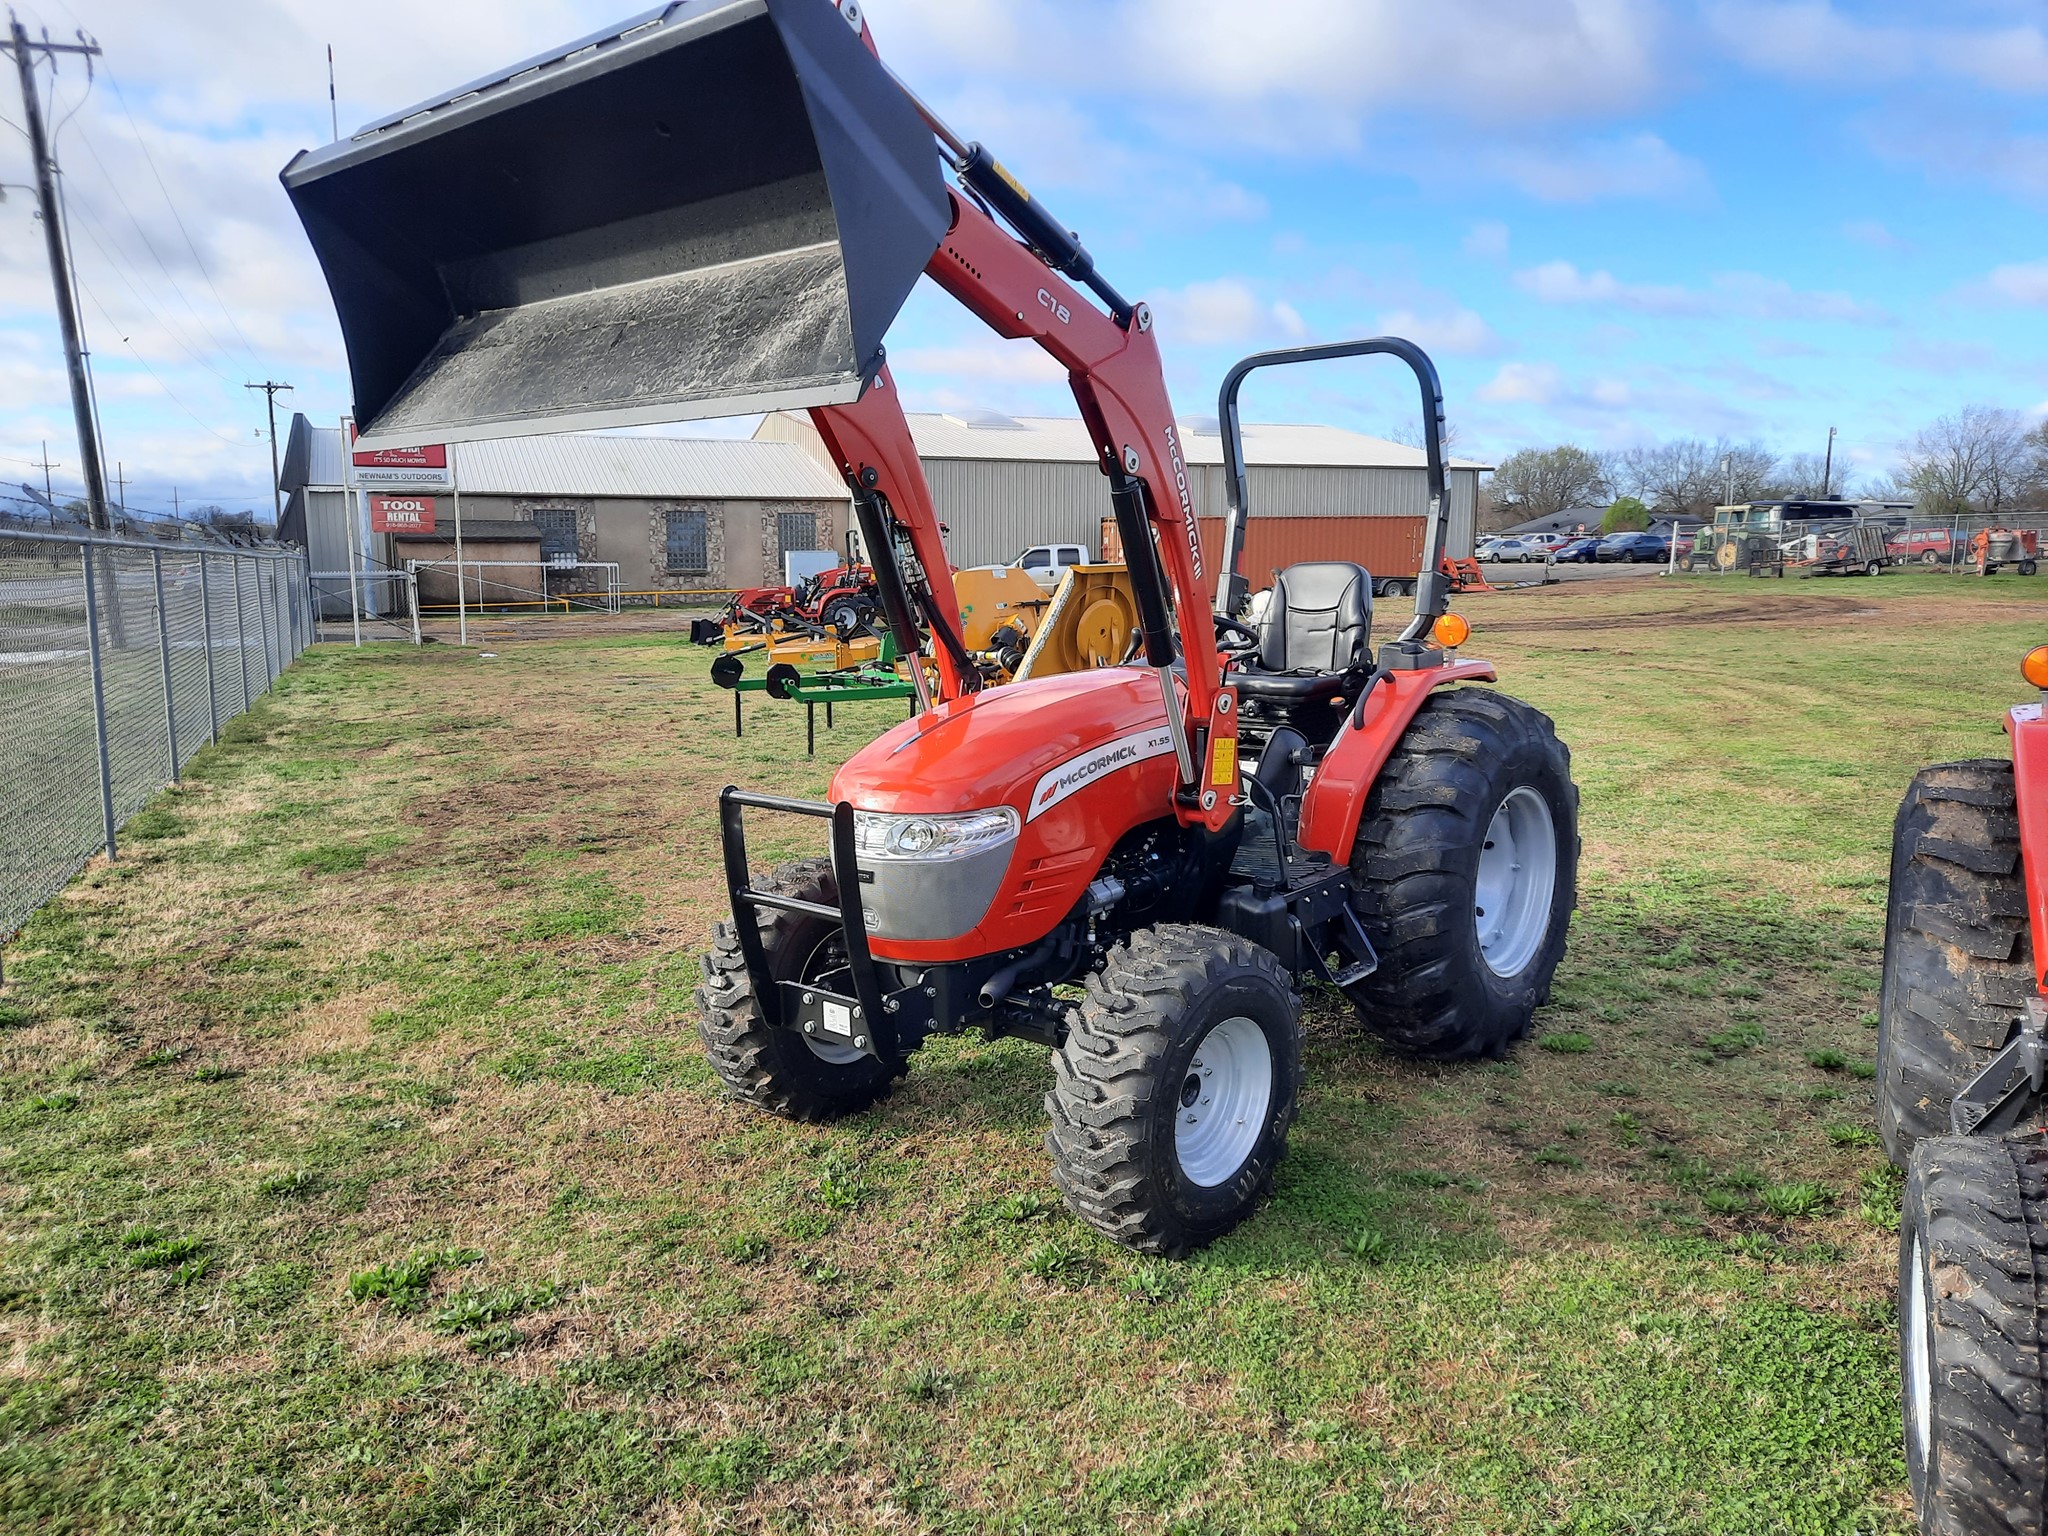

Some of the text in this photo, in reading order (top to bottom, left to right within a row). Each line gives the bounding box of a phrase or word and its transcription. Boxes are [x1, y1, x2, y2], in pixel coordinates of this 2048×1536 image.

[1037, 288, 1071, 324] C18
[358, 472, 400, 480] NEWNAM'S
[1164, 425, 1200, 562] McCORMICK
[379, 500, 425, 511] TOOL
[386, 511, 420, 522] RENTAL
[1148, 735, 1170, 748] X1.55
[1059, 744, 1137, 789] McCORMICK
